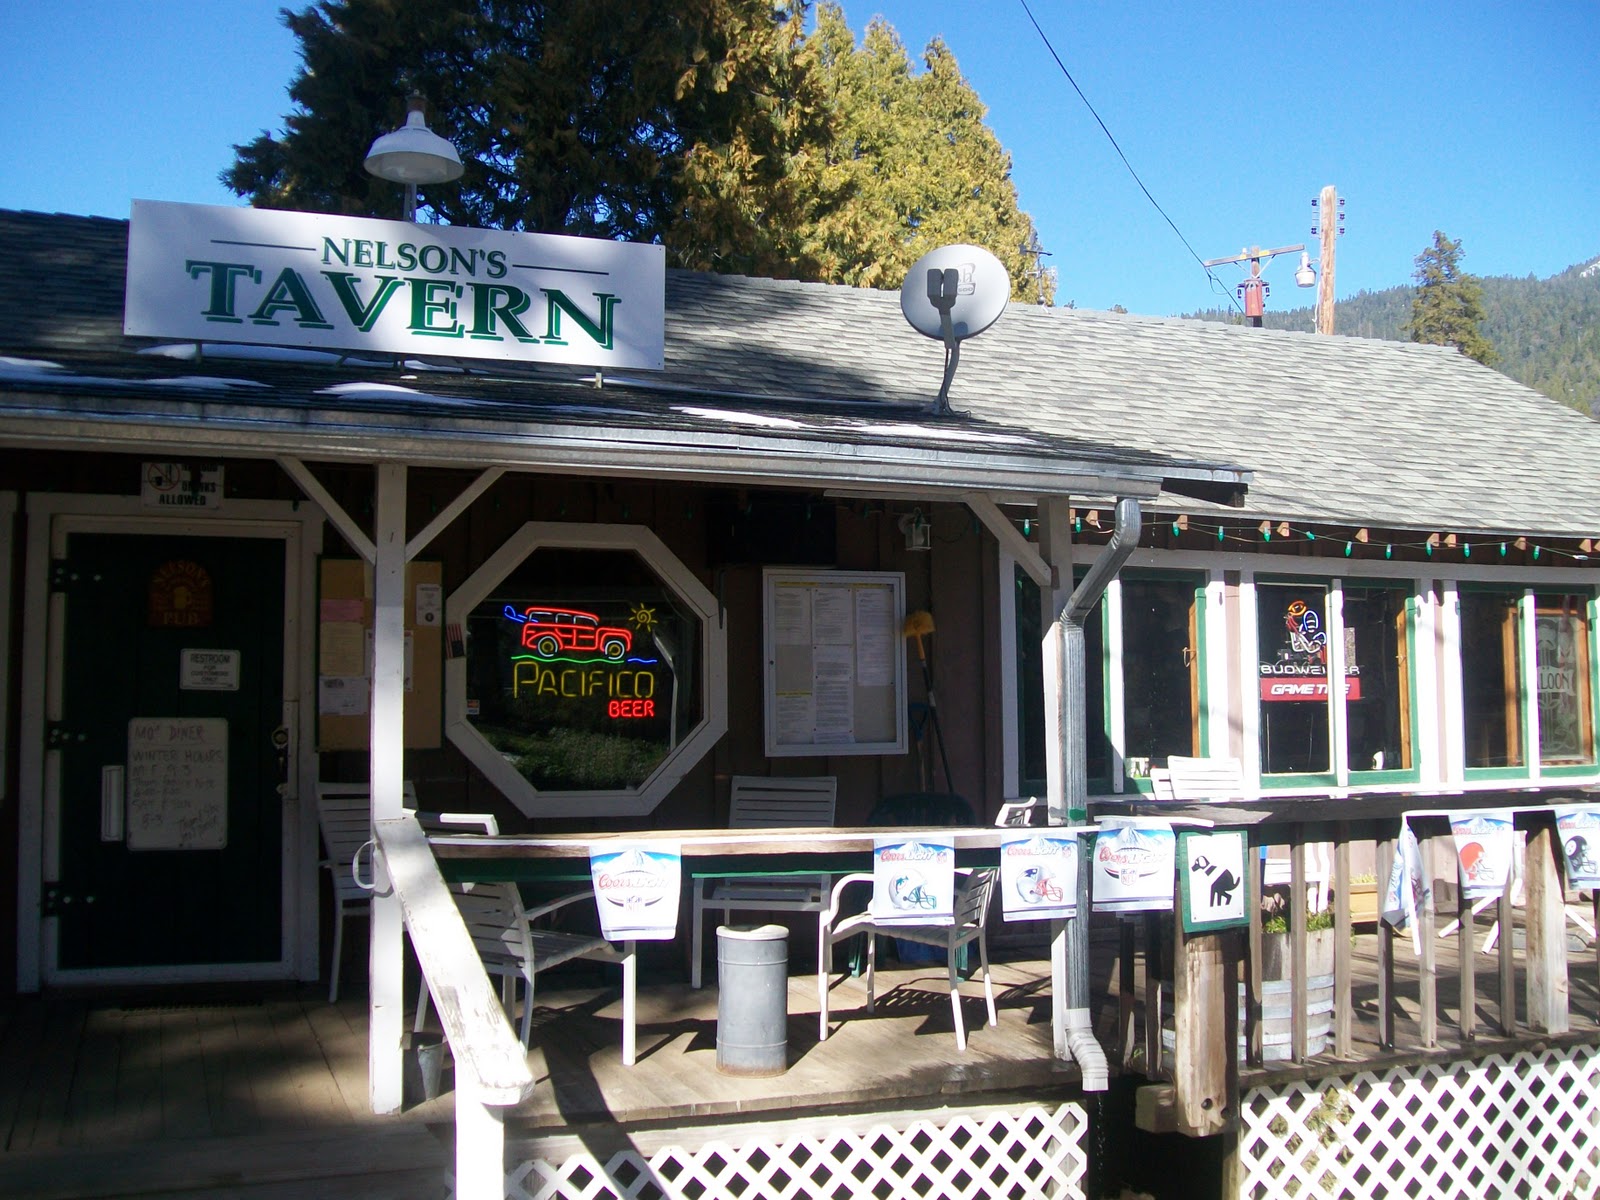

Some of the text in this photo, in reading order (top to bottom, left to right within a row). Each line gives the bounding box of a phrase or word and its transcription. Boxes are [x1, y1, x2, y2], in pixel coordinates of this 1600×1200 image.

[320, 236, 507, 279] NELSON'S
[185, 259, 621, 350] TAVERN
[159, 494, 206, 506] ALLOWED
[191, 653, 231, 664] RESTROOM
[1260, 664, 1361, 675] BUDWEIER
[513, 661, 656, 699] PACIFICO
[1271, 683, 1351, 695] GAME TIE
[608, 699, 656, 719] BEER
[132, 750, 179, 762] WINTER
[905, 850, 935, 861] LIGHT
[597, 873, 631, 890] Coors
